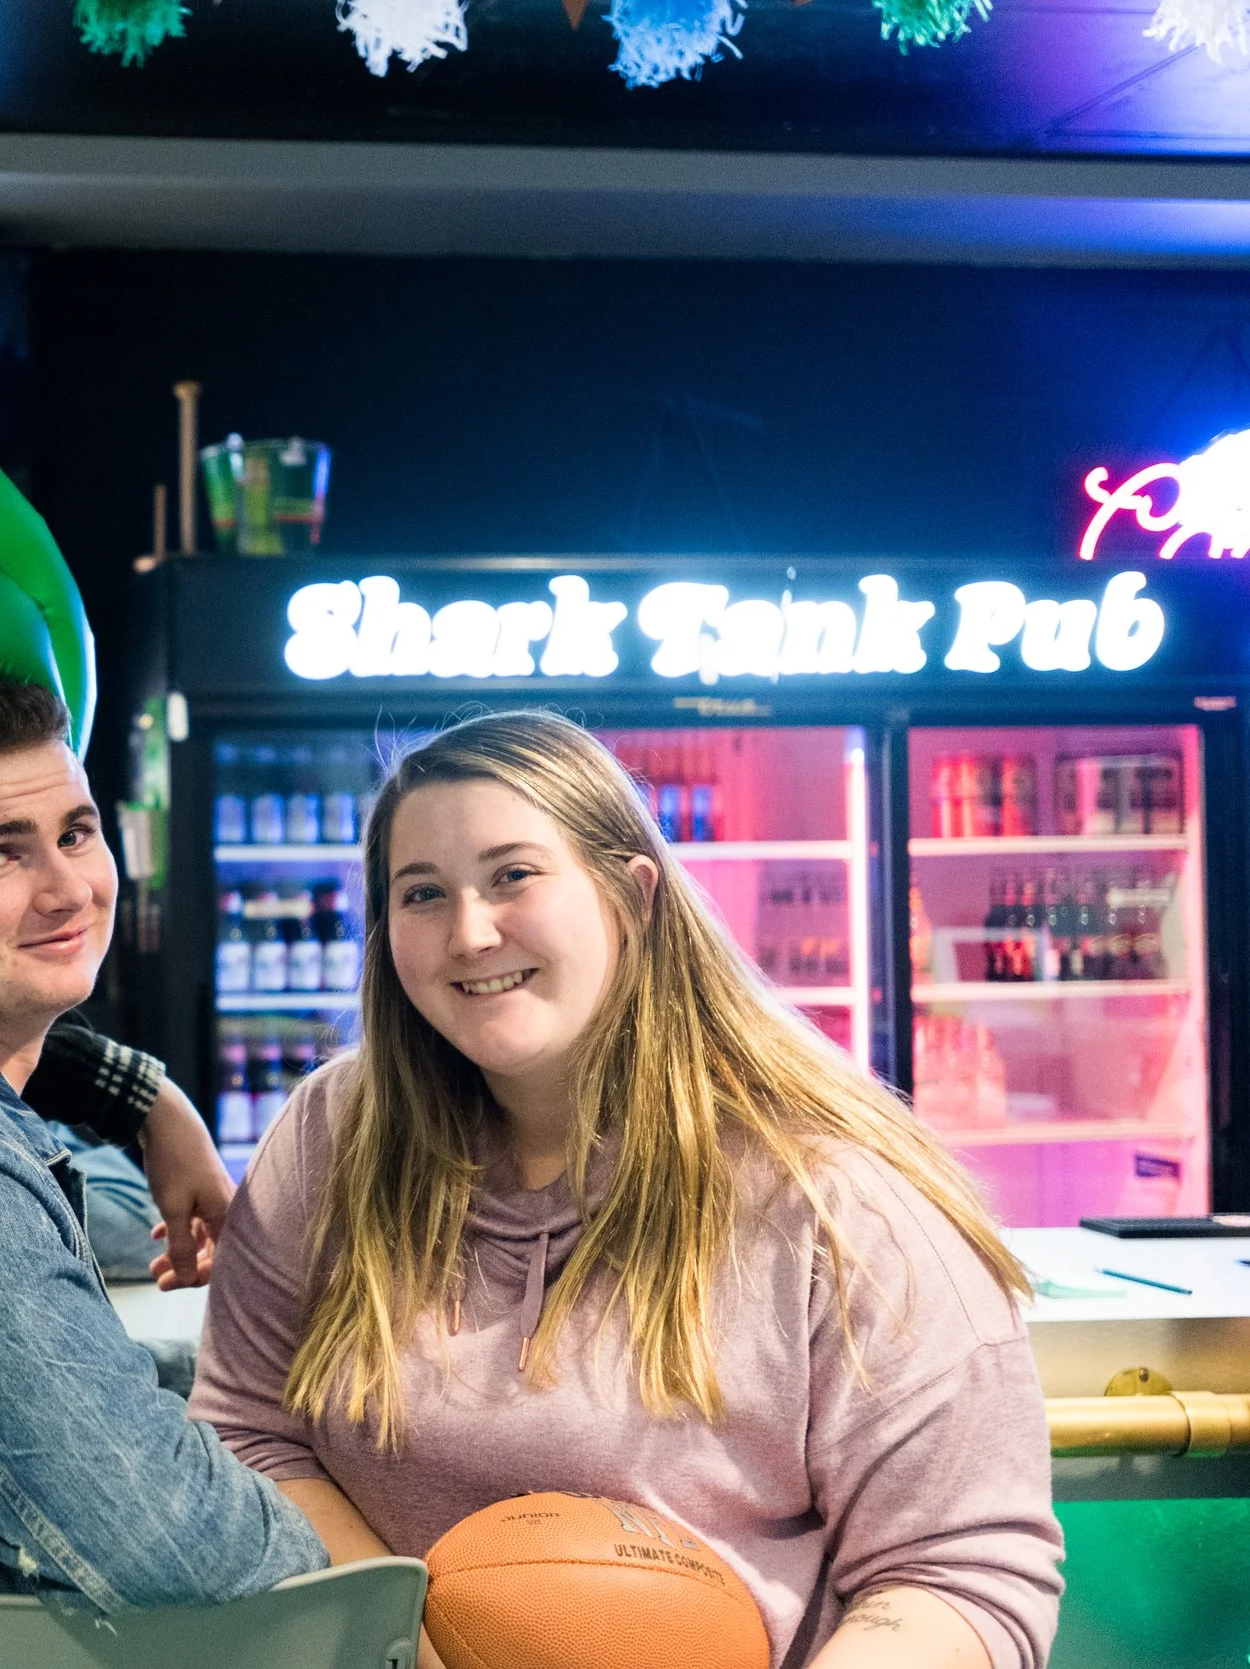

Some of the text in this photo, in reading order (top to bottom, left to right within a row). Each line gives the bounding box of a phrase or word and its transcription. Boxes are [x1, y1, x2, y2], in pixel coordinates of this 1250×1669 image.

[284, 571, 1165, 679] Shark Tank Pub
[614, 1543, 726, 1585] ULTIMATE COMPOSITE
